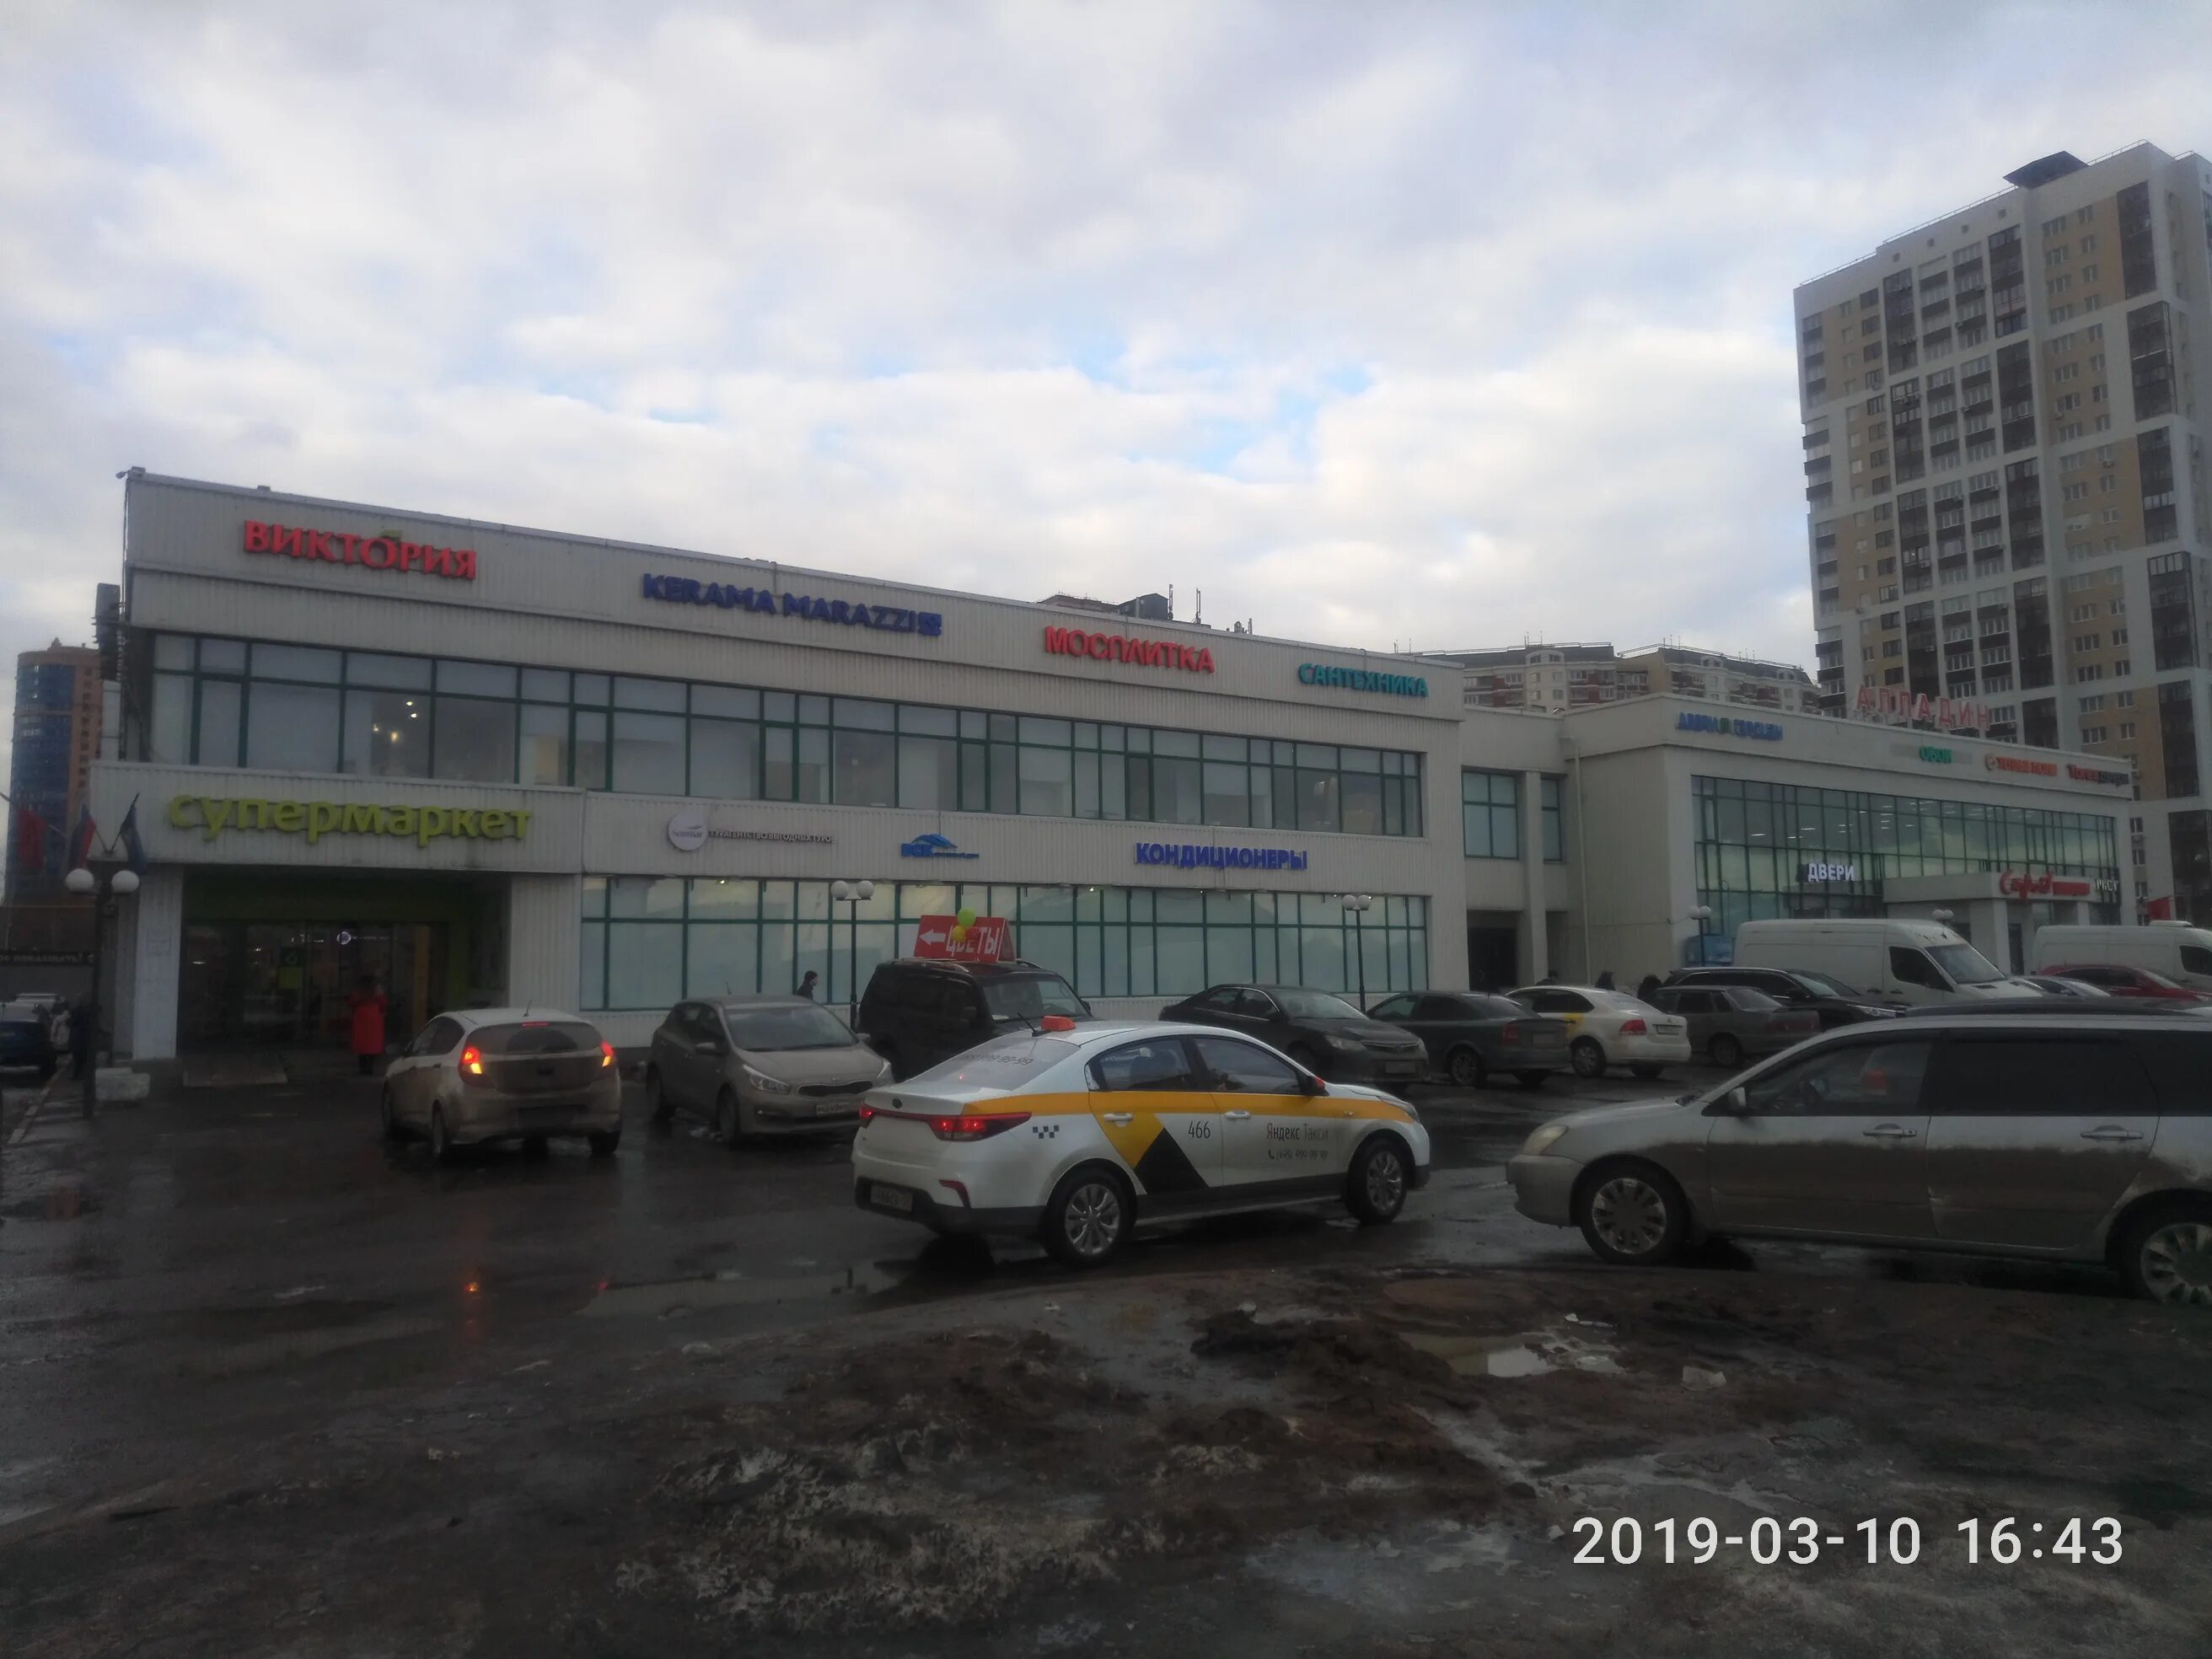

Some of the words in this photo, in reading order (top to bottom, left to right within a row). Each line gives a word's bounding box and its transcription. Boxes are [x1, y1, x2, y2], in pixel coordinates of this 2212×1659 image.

[244, 519, 477, 580] ВИКТОРИЯ
[642, 573, 776, 615] KERAMA
[782, 593, 917, 633] MARAZZI
[1044, 625, 1216, 674] МОСПЛИТКА
[1299, 663, 1429, 697] САНТЕХНИКА
[1919, 746, 1952, 763] ОБОИ
[169, 794, 532, 847] супермаркет
[1135, 842, 1308, 871] КОНДИЦИОНЕРЫ
[1807, 862, 1855, 883] ДВЕРИ
[1188, 1119, 1211, 1139] 466
[1266, 1122, 1300, 1141] Яндекс
[1302, 1123, 1329, 1141] Такси
